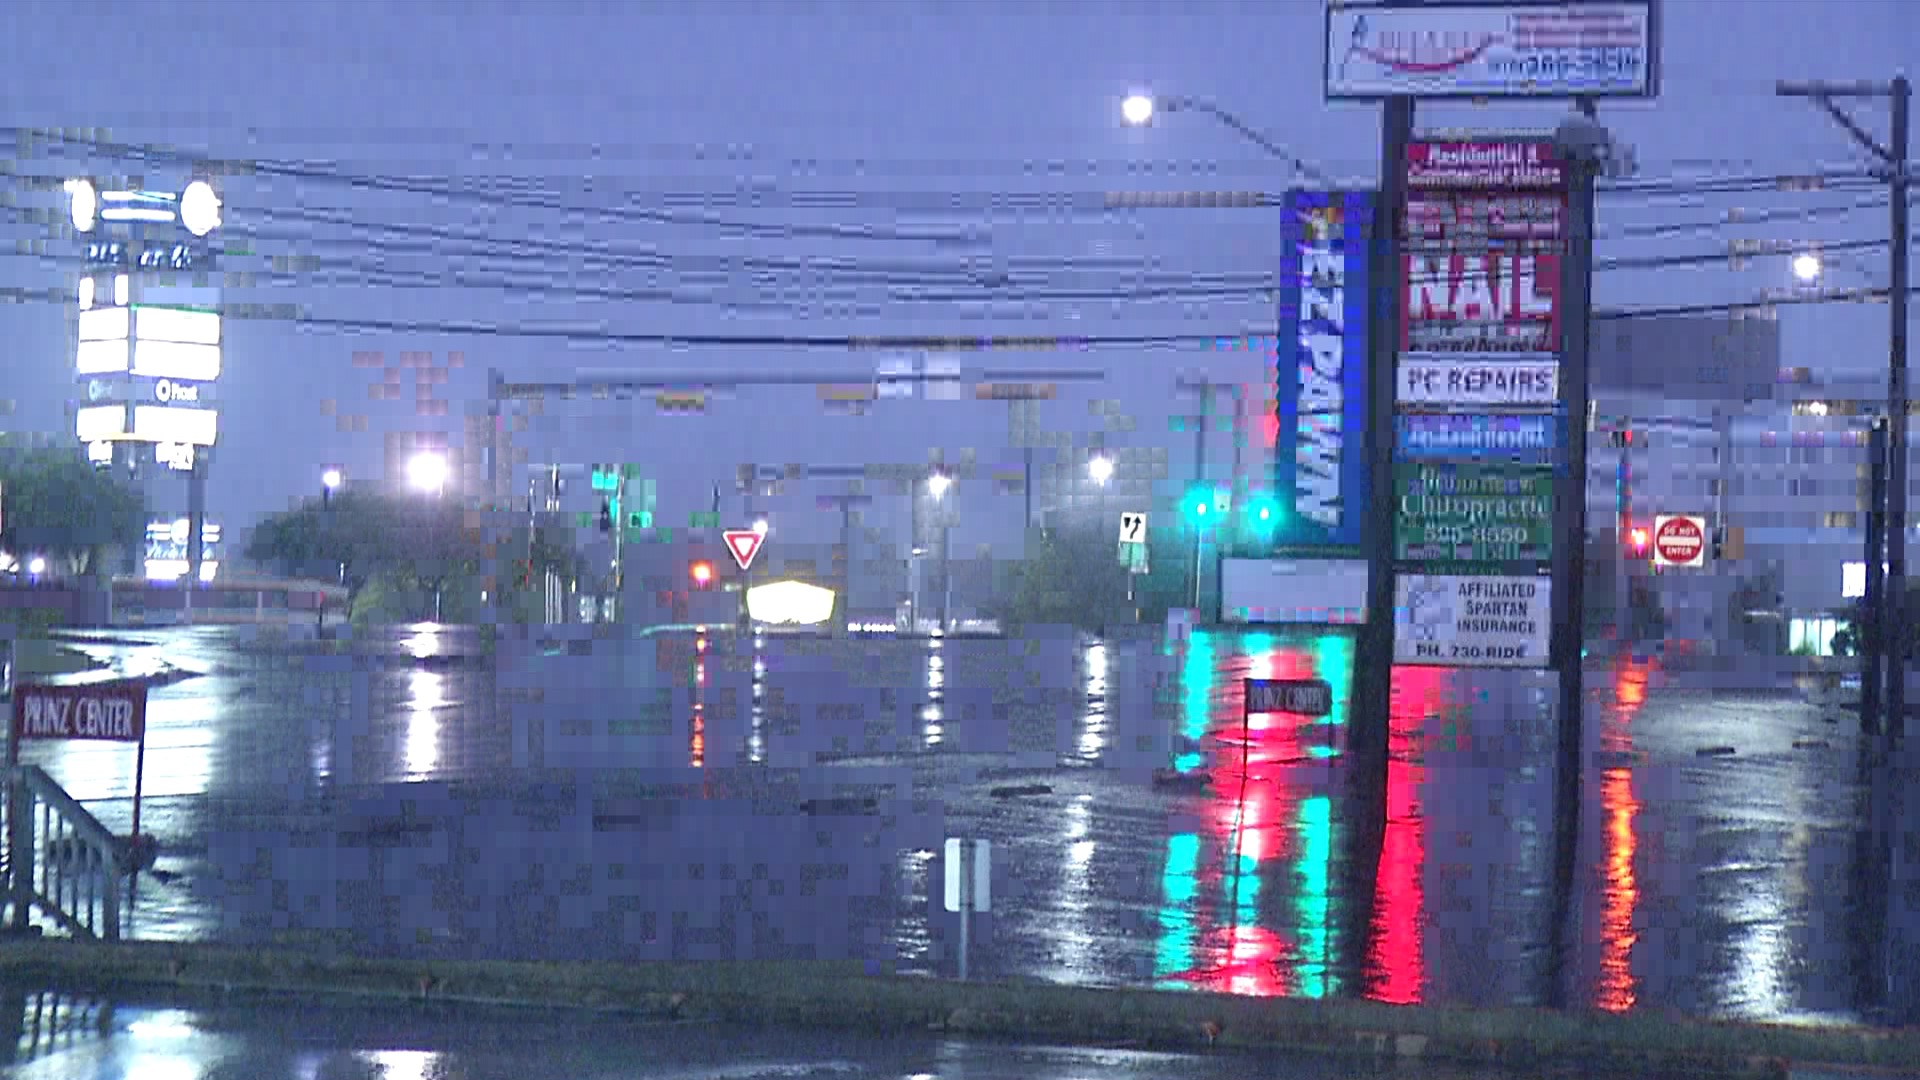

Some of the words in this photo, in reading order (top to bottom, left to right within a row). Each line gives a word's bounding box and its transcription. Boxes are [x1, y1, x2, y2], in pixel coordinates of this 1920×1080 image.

[1408, 256, 1552, 319] NAIL
[1448, 367, 1553, 397] REPAIRS
[1664, 527, 1676, 536] DO
[1666, 546, 1692, 556] ENTER
[1458, 582, 1535, 599] AFFILIATED
[1466, 600, 1528, 616] SPARTAN
[1457, 618, 1536, 634] INSURANCE
[24, 695, 70, 734] PRINZ
[75, 697, 134, 736] CENTER
